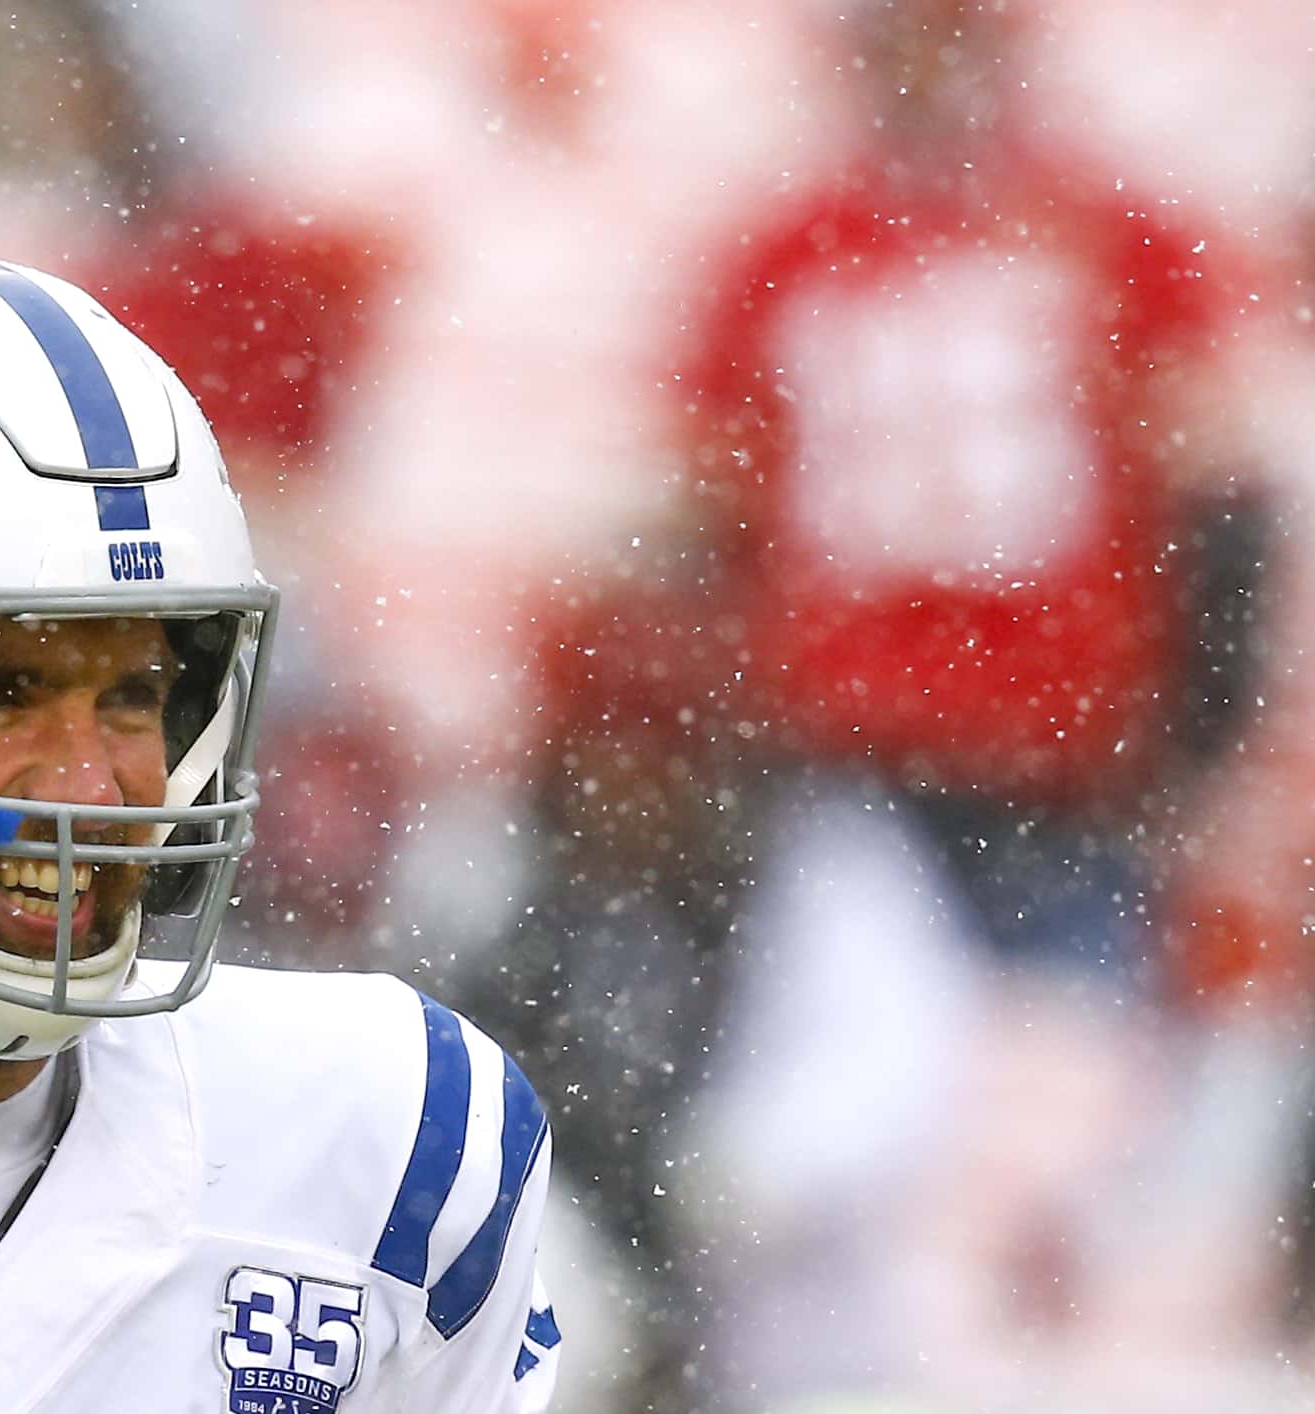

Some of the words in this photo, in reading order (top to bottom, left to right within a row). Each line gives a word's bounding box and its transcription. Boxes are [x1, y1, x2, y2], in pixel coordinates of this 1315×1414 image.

[108, 541, 164, 581] COLTS
[223, 1268, 363, 1391] 35
[243, 1370, 332, 1401] SEASONS
[238, 1399, 265, 1414] 1984
